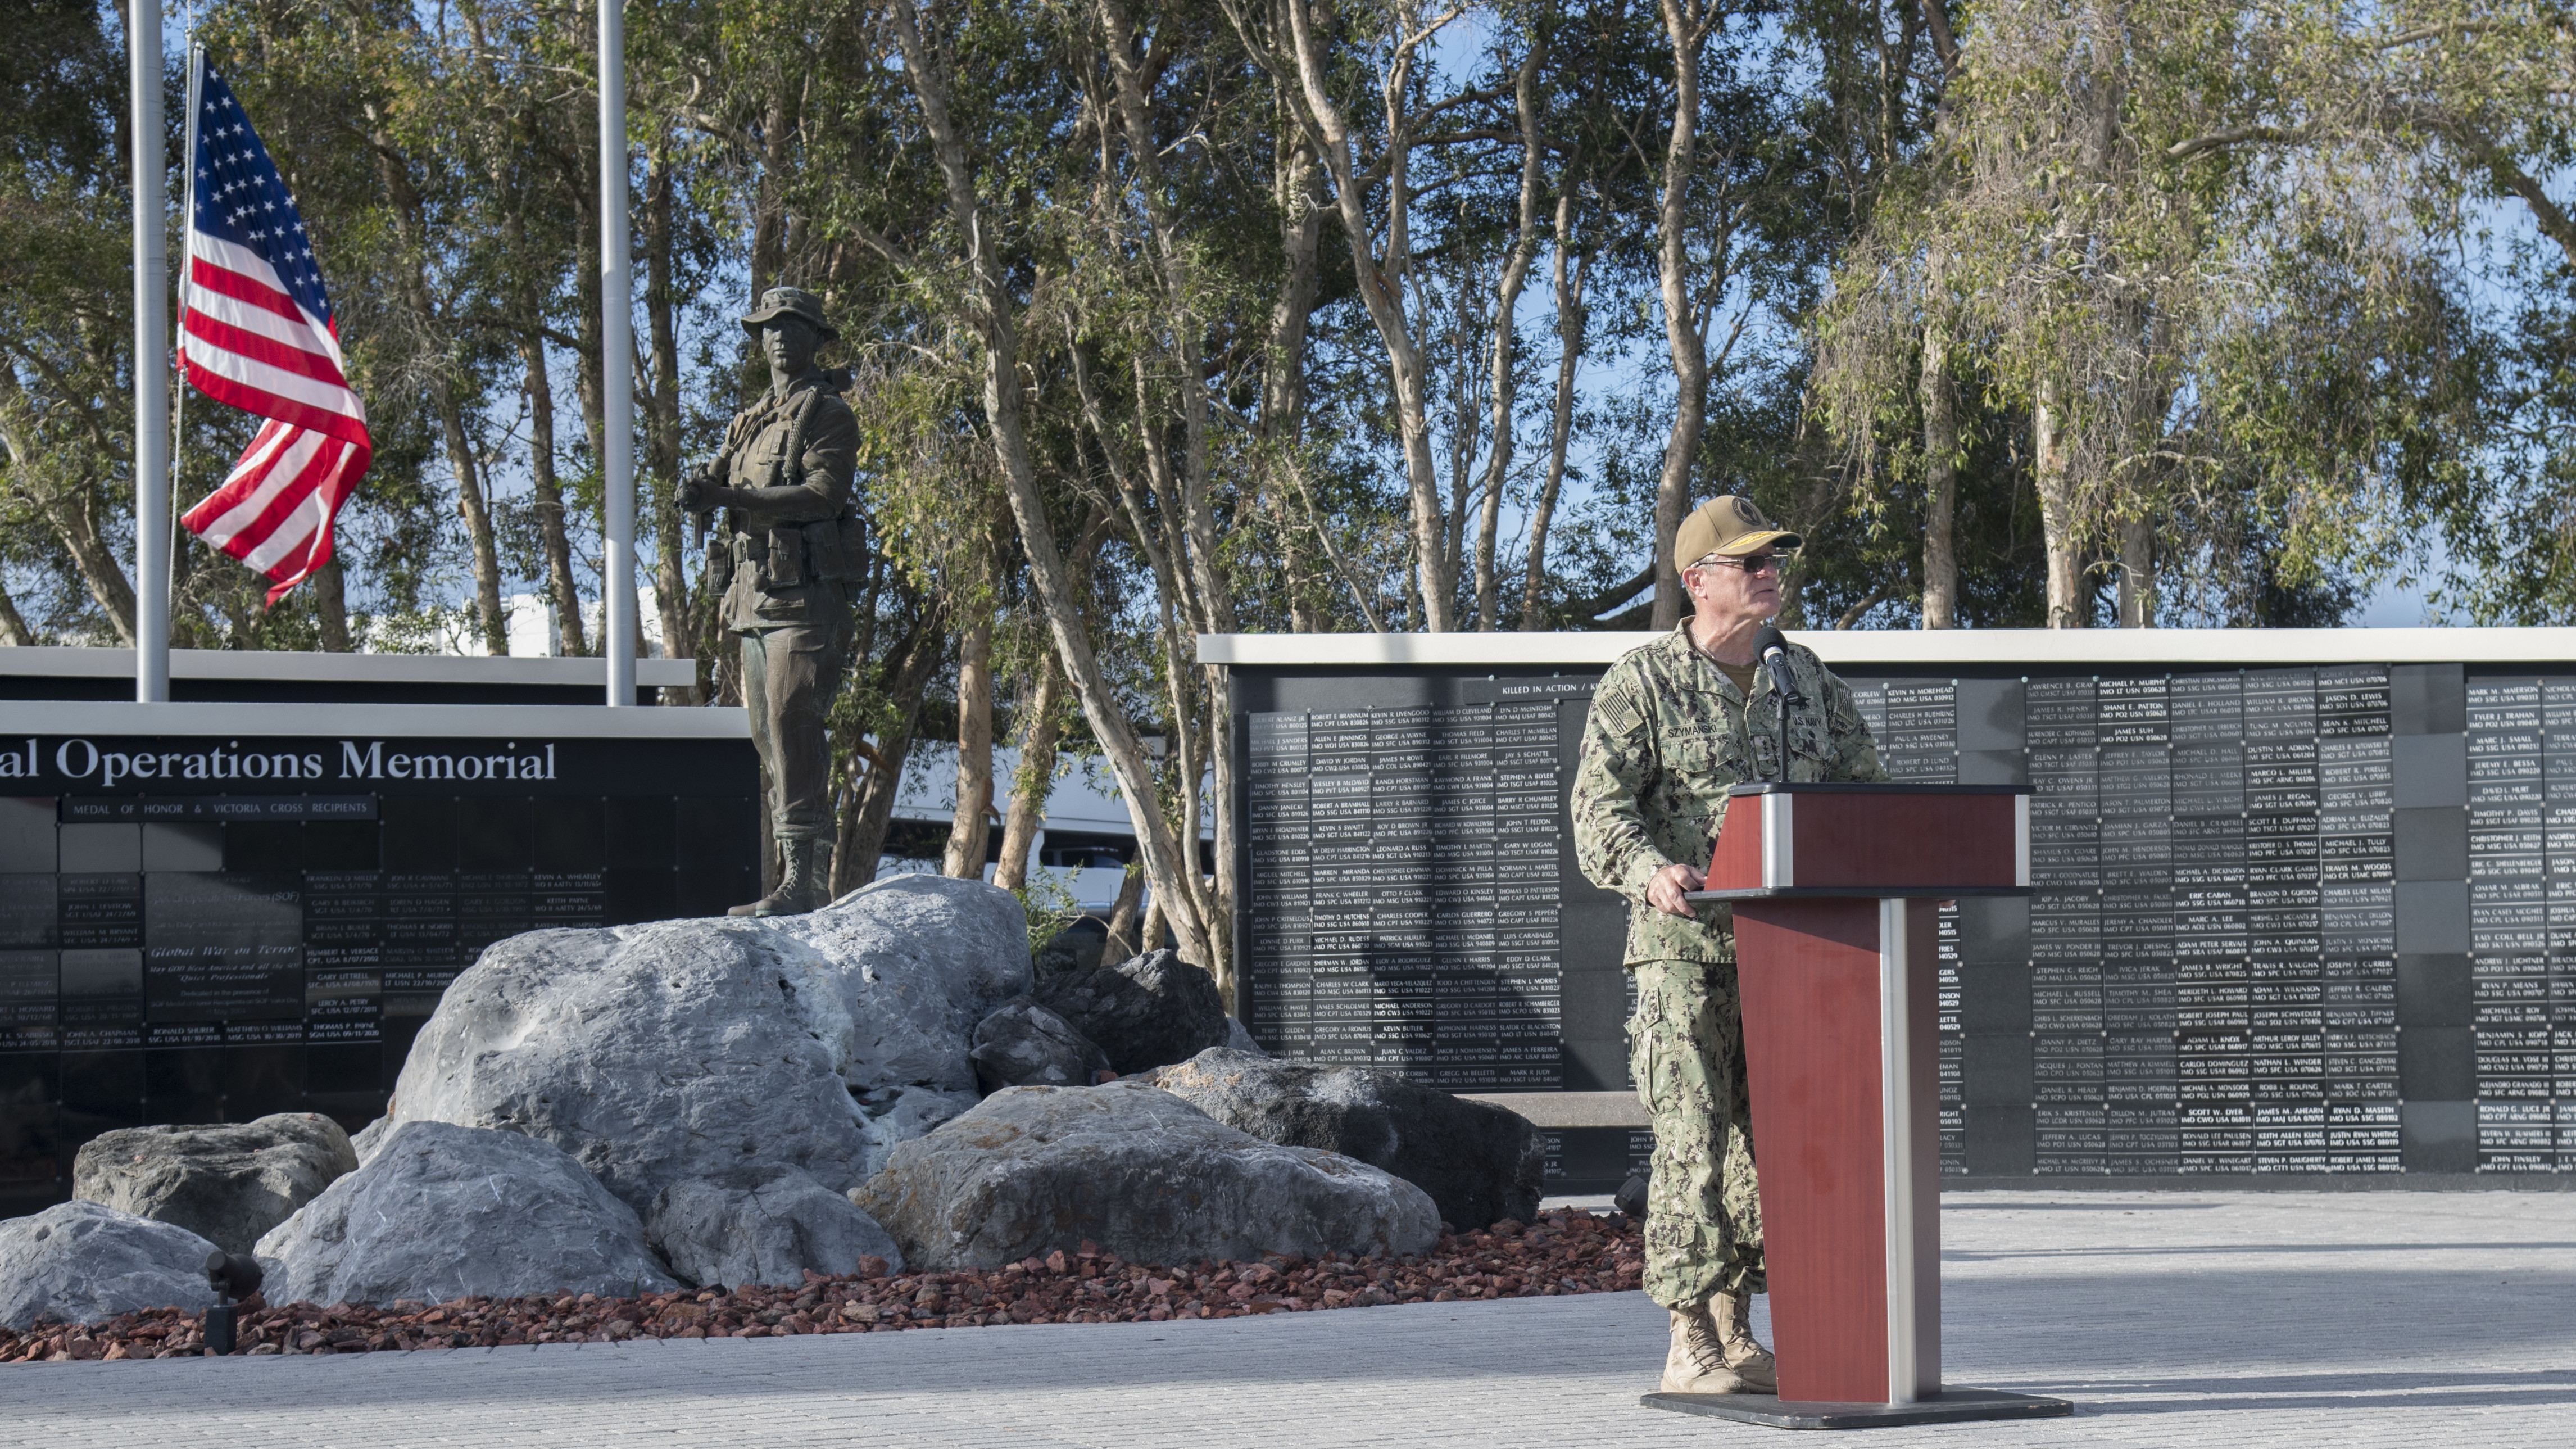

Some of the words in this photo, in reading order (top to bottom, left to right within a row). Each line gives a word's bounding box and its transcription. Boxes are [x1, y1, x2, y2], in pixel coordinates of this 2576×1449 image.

[1792, 717, 1805, 726] U.S.
[1805, 717, 1821, 727] NAVY
[1668, 724, 1717, 738] SZYMANSKI
[57, 740, 323, 786] Operations
[339, 740, 557, 780] Memorial
[74, 805, 110, 814] MEDAL
[121, 805, 134, 814] OF
[145, 805, 183, 813] HONOR
[195, 805, 201, 813] &
[214, 804, 260, 813] VICTORIA
[270, 804, 303, 812] CROSS
[312, 803, 367, 812] RECIPIENTS
[151, 947, 195, 957] Global
[203, 946, 229, 956] War
[235, 947, 251, 955] on
[258, 945, 297, 954] Terror
